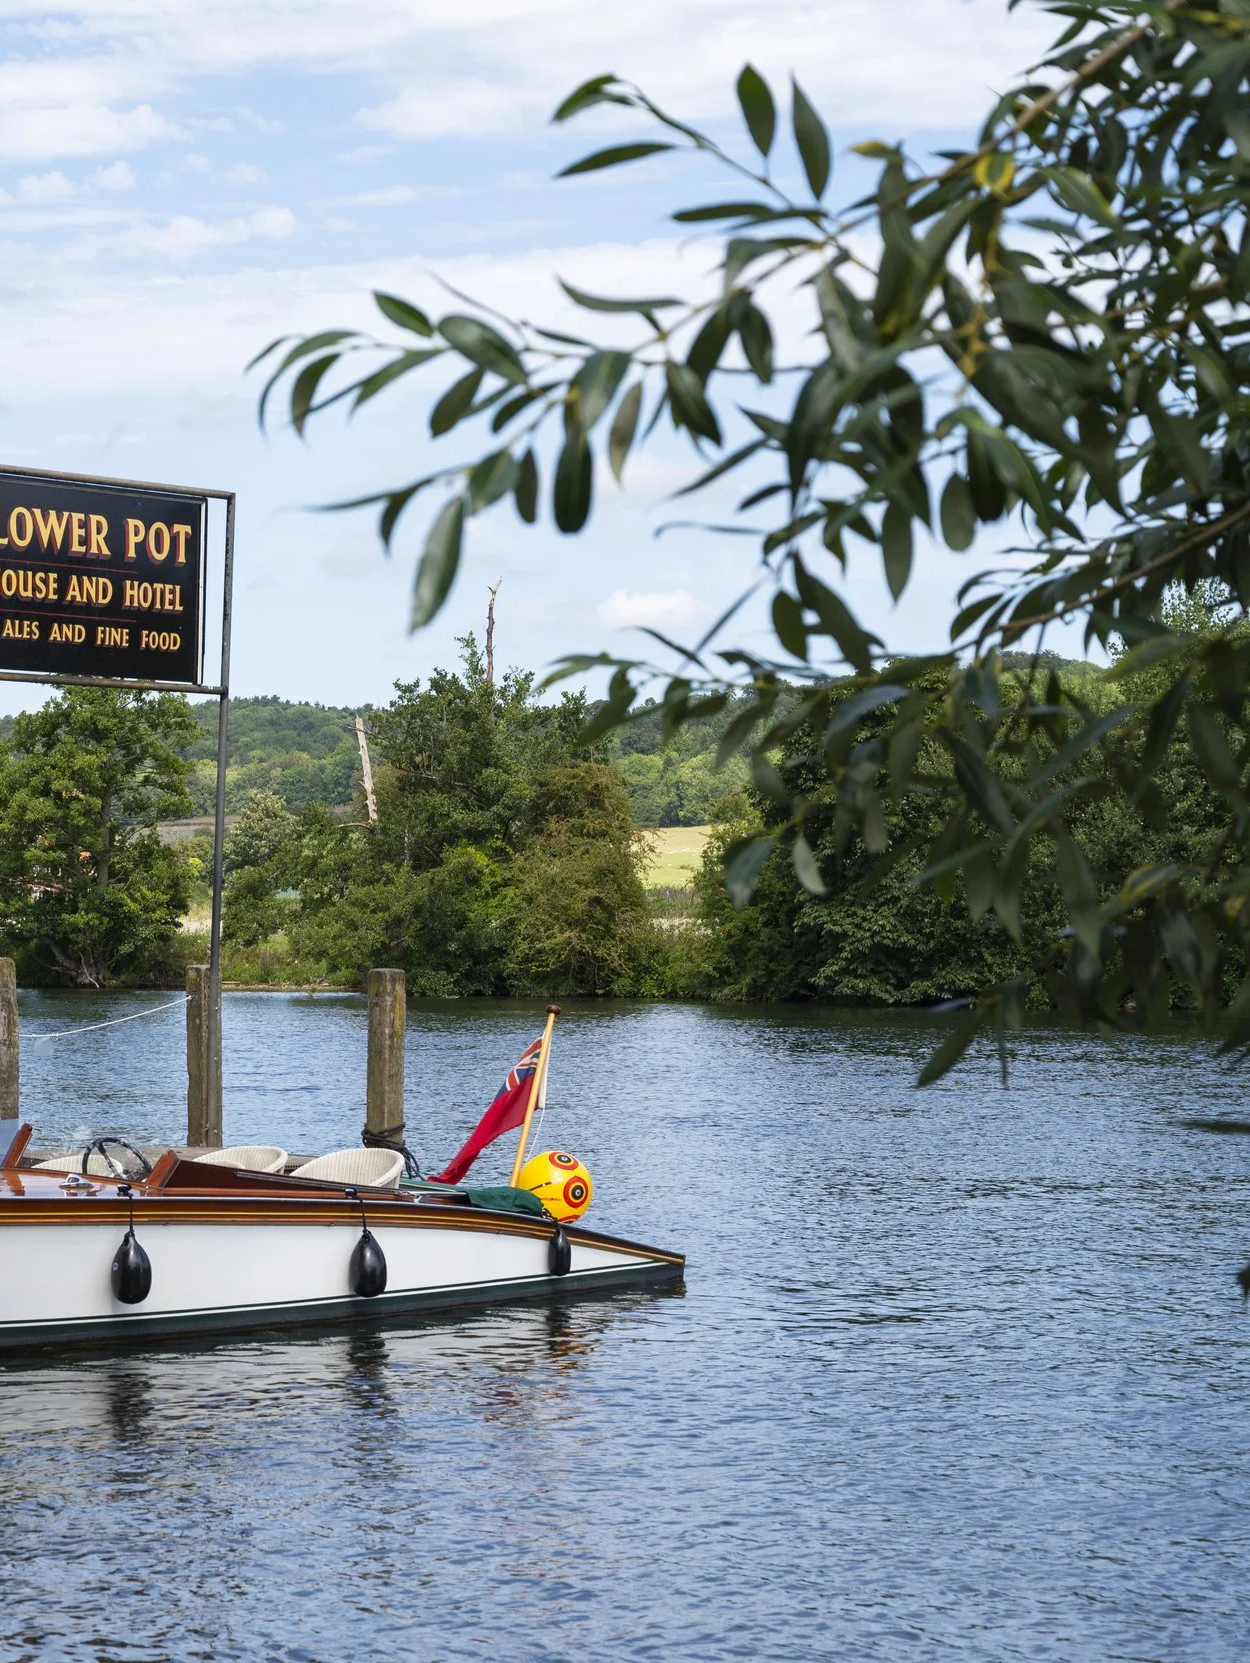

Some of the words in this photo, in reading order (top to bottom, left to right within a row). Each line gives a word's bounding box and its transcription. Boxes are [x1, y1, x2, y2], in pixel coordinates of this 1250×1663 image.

[125, 517, 192, 566] POT
[65, 574, 113, 606] AND
[121, 579, 184, 613] HOTEL
[2, 619, 40, 641] ALES
[49, 623, 86, 645] AND
[96, 626, 130, 648] FINE
[140, 630, 181, 653] FOOD
